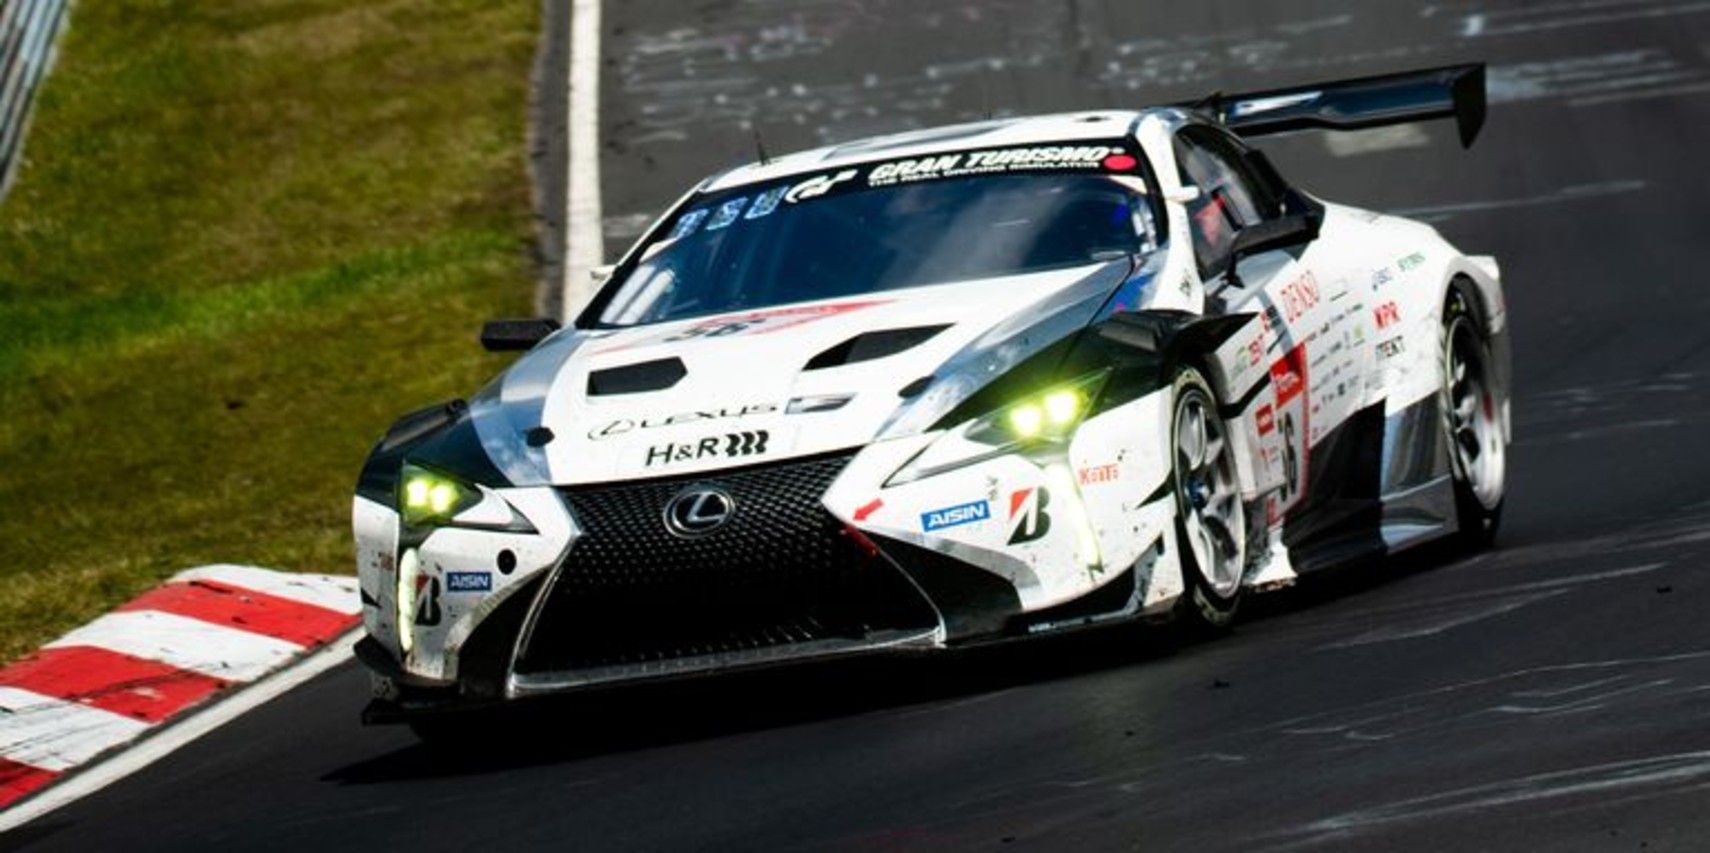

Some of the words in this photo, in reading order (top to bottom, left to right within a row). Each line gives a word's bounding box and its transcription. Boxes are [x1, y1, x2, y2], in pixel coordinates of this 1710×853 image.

[868, 153, 963, 181] GRAN
[964, 146, 1110, 169] TURISMO
[640, 402, 777, 429] LEXUS
[645, 437, 719, 467] H&R
[927, 502, 985, 530] AISIN
[450, 573, 490, 589] AISIN
